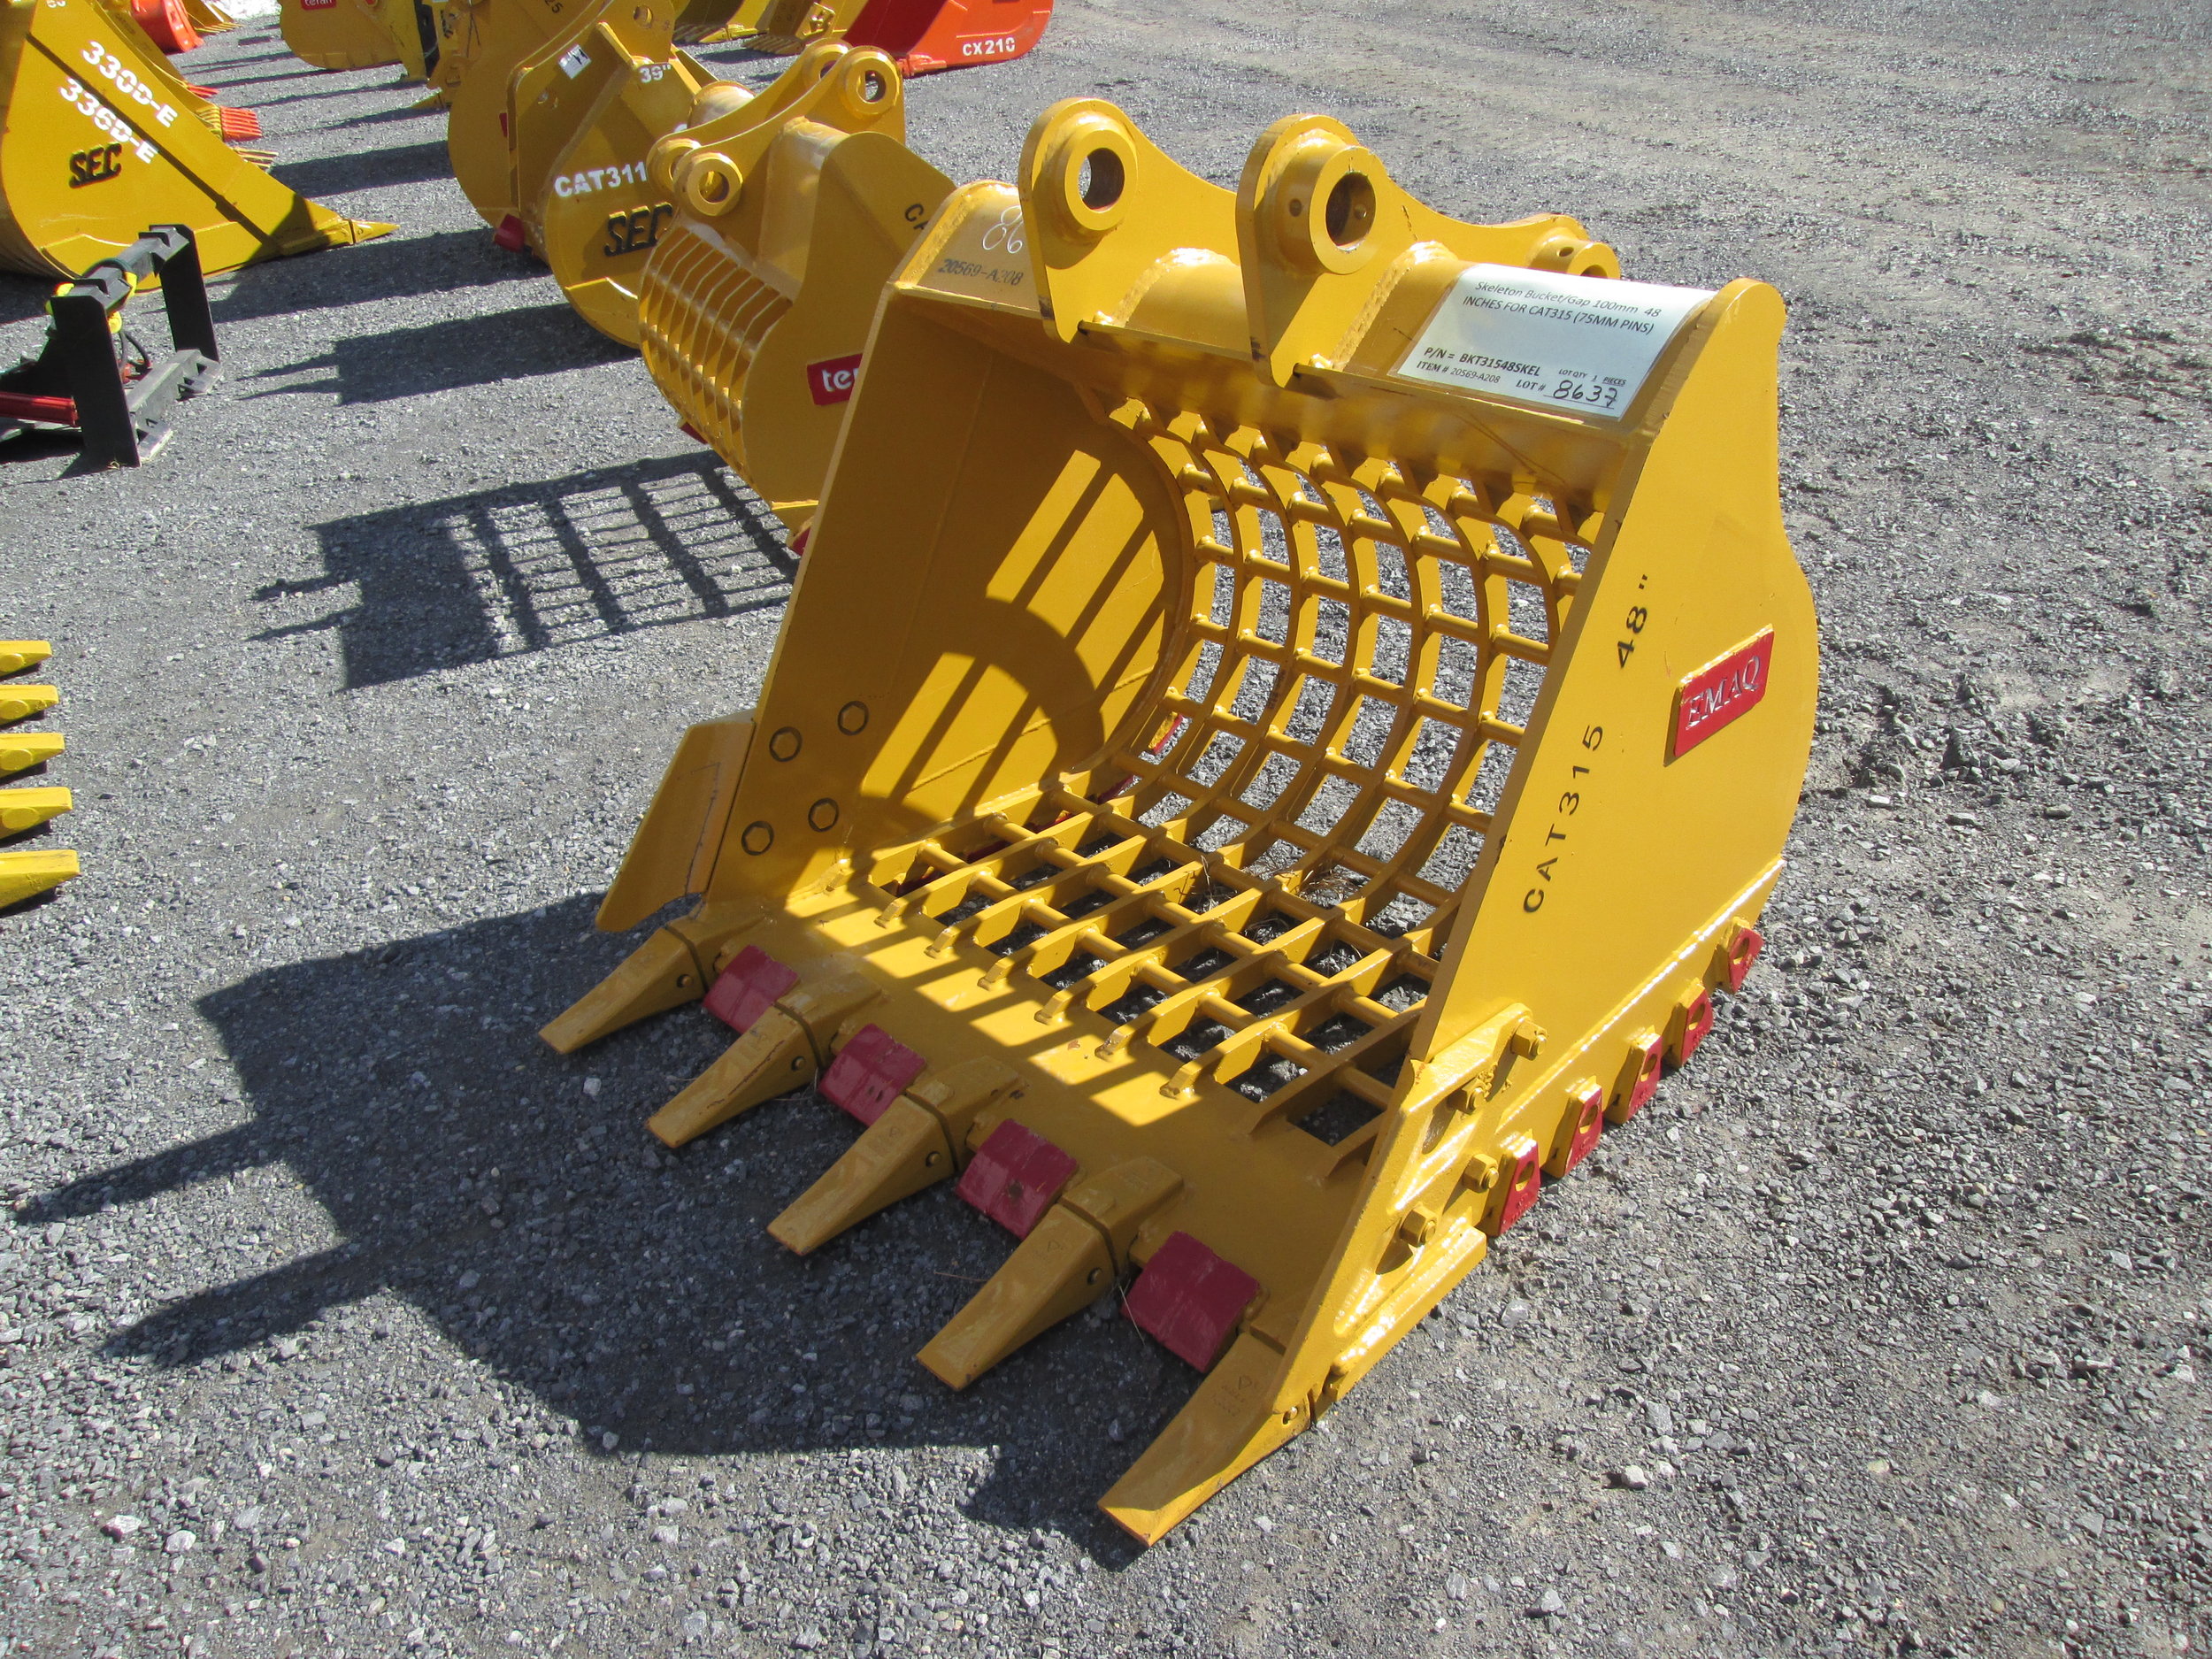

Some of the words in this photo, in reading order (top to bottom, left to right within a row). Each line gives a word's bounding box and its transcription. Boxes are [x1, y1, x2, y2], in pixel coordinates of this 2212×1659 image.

[962, 37, 1016, 57] CX210
[81, 41, 178, 127] 330D-E
[59, 77, 158, 164] 336D-E
[69, 142, 122, 188] SEC
[554, 161, 648, 197] CAT311
[603, 202, 673, 257] SEC
[1463, 296, 1504, 310] INCHES
[1503, 302, 1527, 313] FOR
[1528, 306, 1571, 320] CAT315
[1573, 311, 1619, 327] (75MM
[1620, 321, 1655, 335] PINS)
[1475, 281, 1523, 296] Skeleton
[1525, 289, 1591, 308] Bucket/Gap
[1592, 299, 1639, 313] 100mm
[1644, 307, 1663, 318] 48
[1416, 361, 1441, 373] ITEM
[1450, 368, 1501, 383] 20569-A208
[1424, 347, 1448, 358] P/N
[1459, 353, 1541, 376] BKT31548SKEL
[1516, 380, 1538, 390] LOT
[1602, 376, 1627, 386] PIECES
[1685, 656, 1761, 730] EMAQ
[1524, 725, 1602, 913] CAT315
[1617, 574, 1648, 669] 48"
